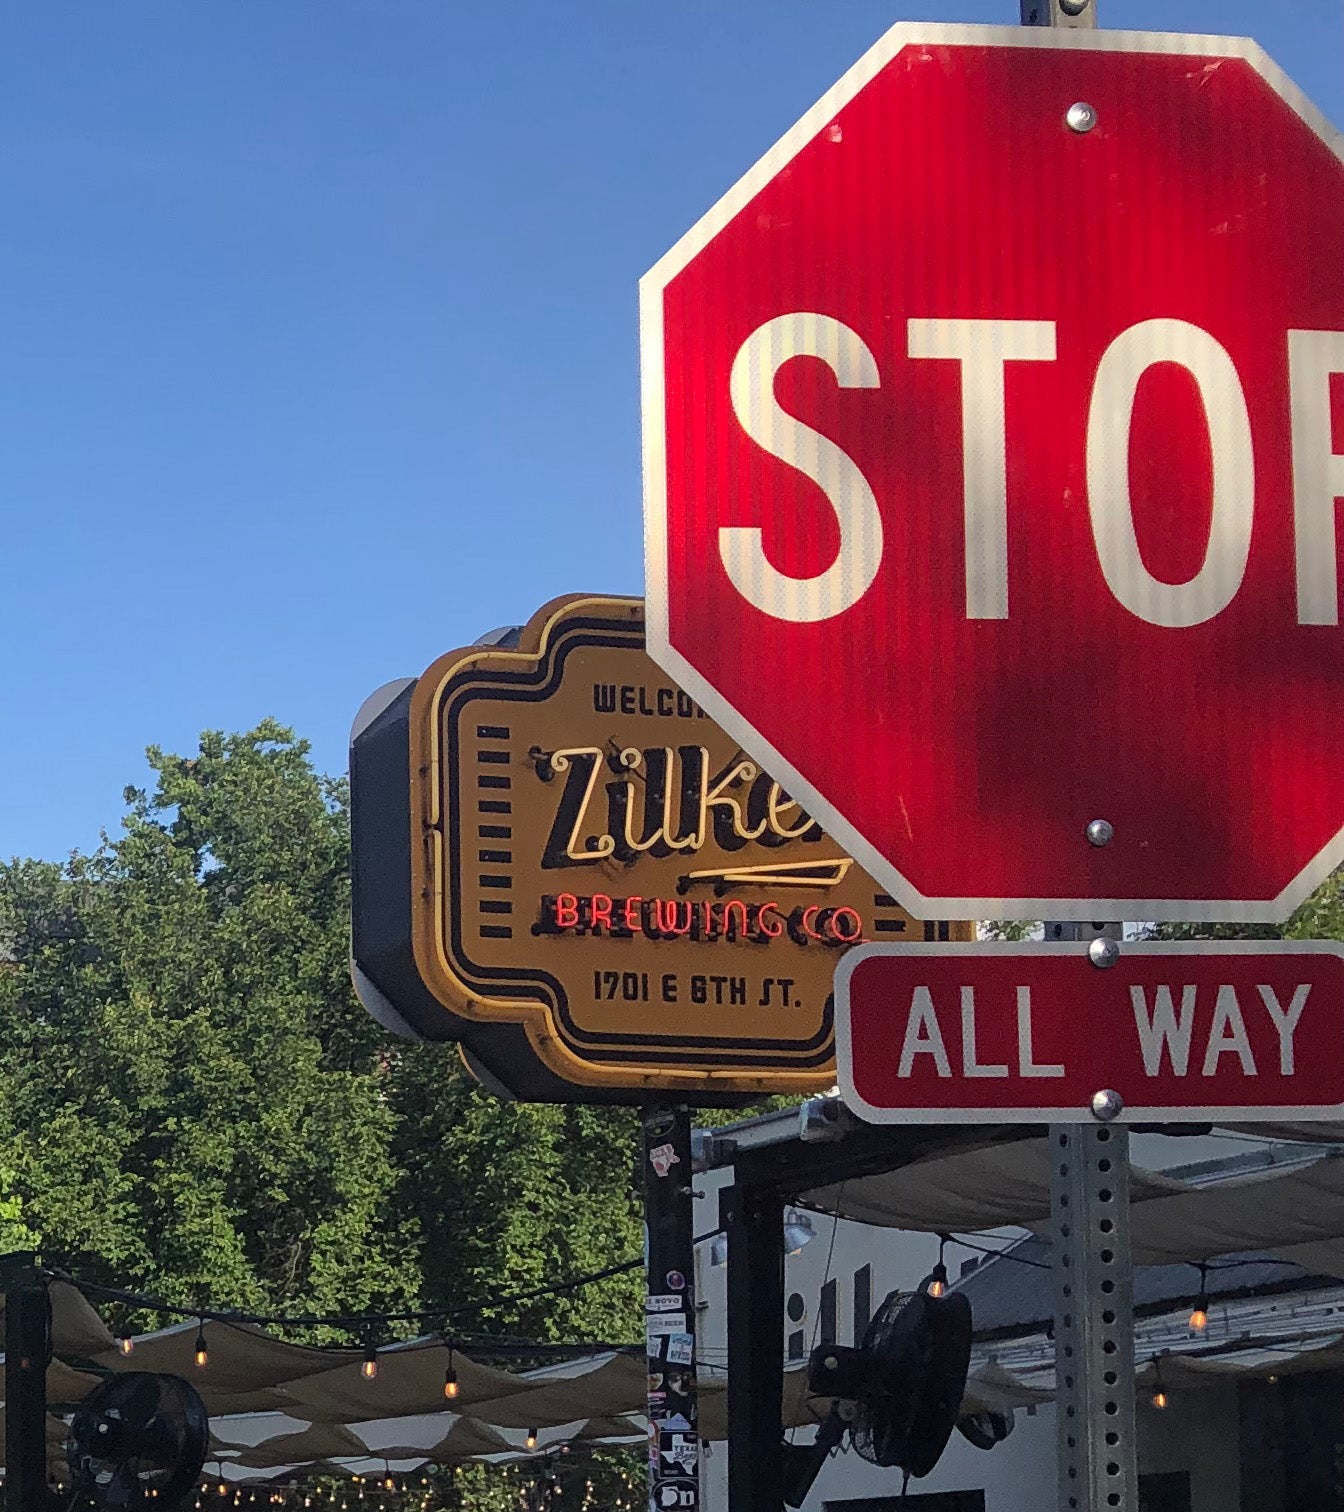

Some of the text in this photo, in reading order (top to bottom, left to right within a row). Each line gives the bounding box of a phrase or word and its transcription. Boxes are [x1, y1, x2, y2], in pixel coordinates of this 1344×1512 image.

[593, 683, 706, 719] WELCO
[530, 745, 826, 869] Zilke
[544, 893, 784, 942] BREWING
[595, 970, 803, 1008] 1701 E 6TH ST.
[897, 983, 1313, 1079] ALL WAY
